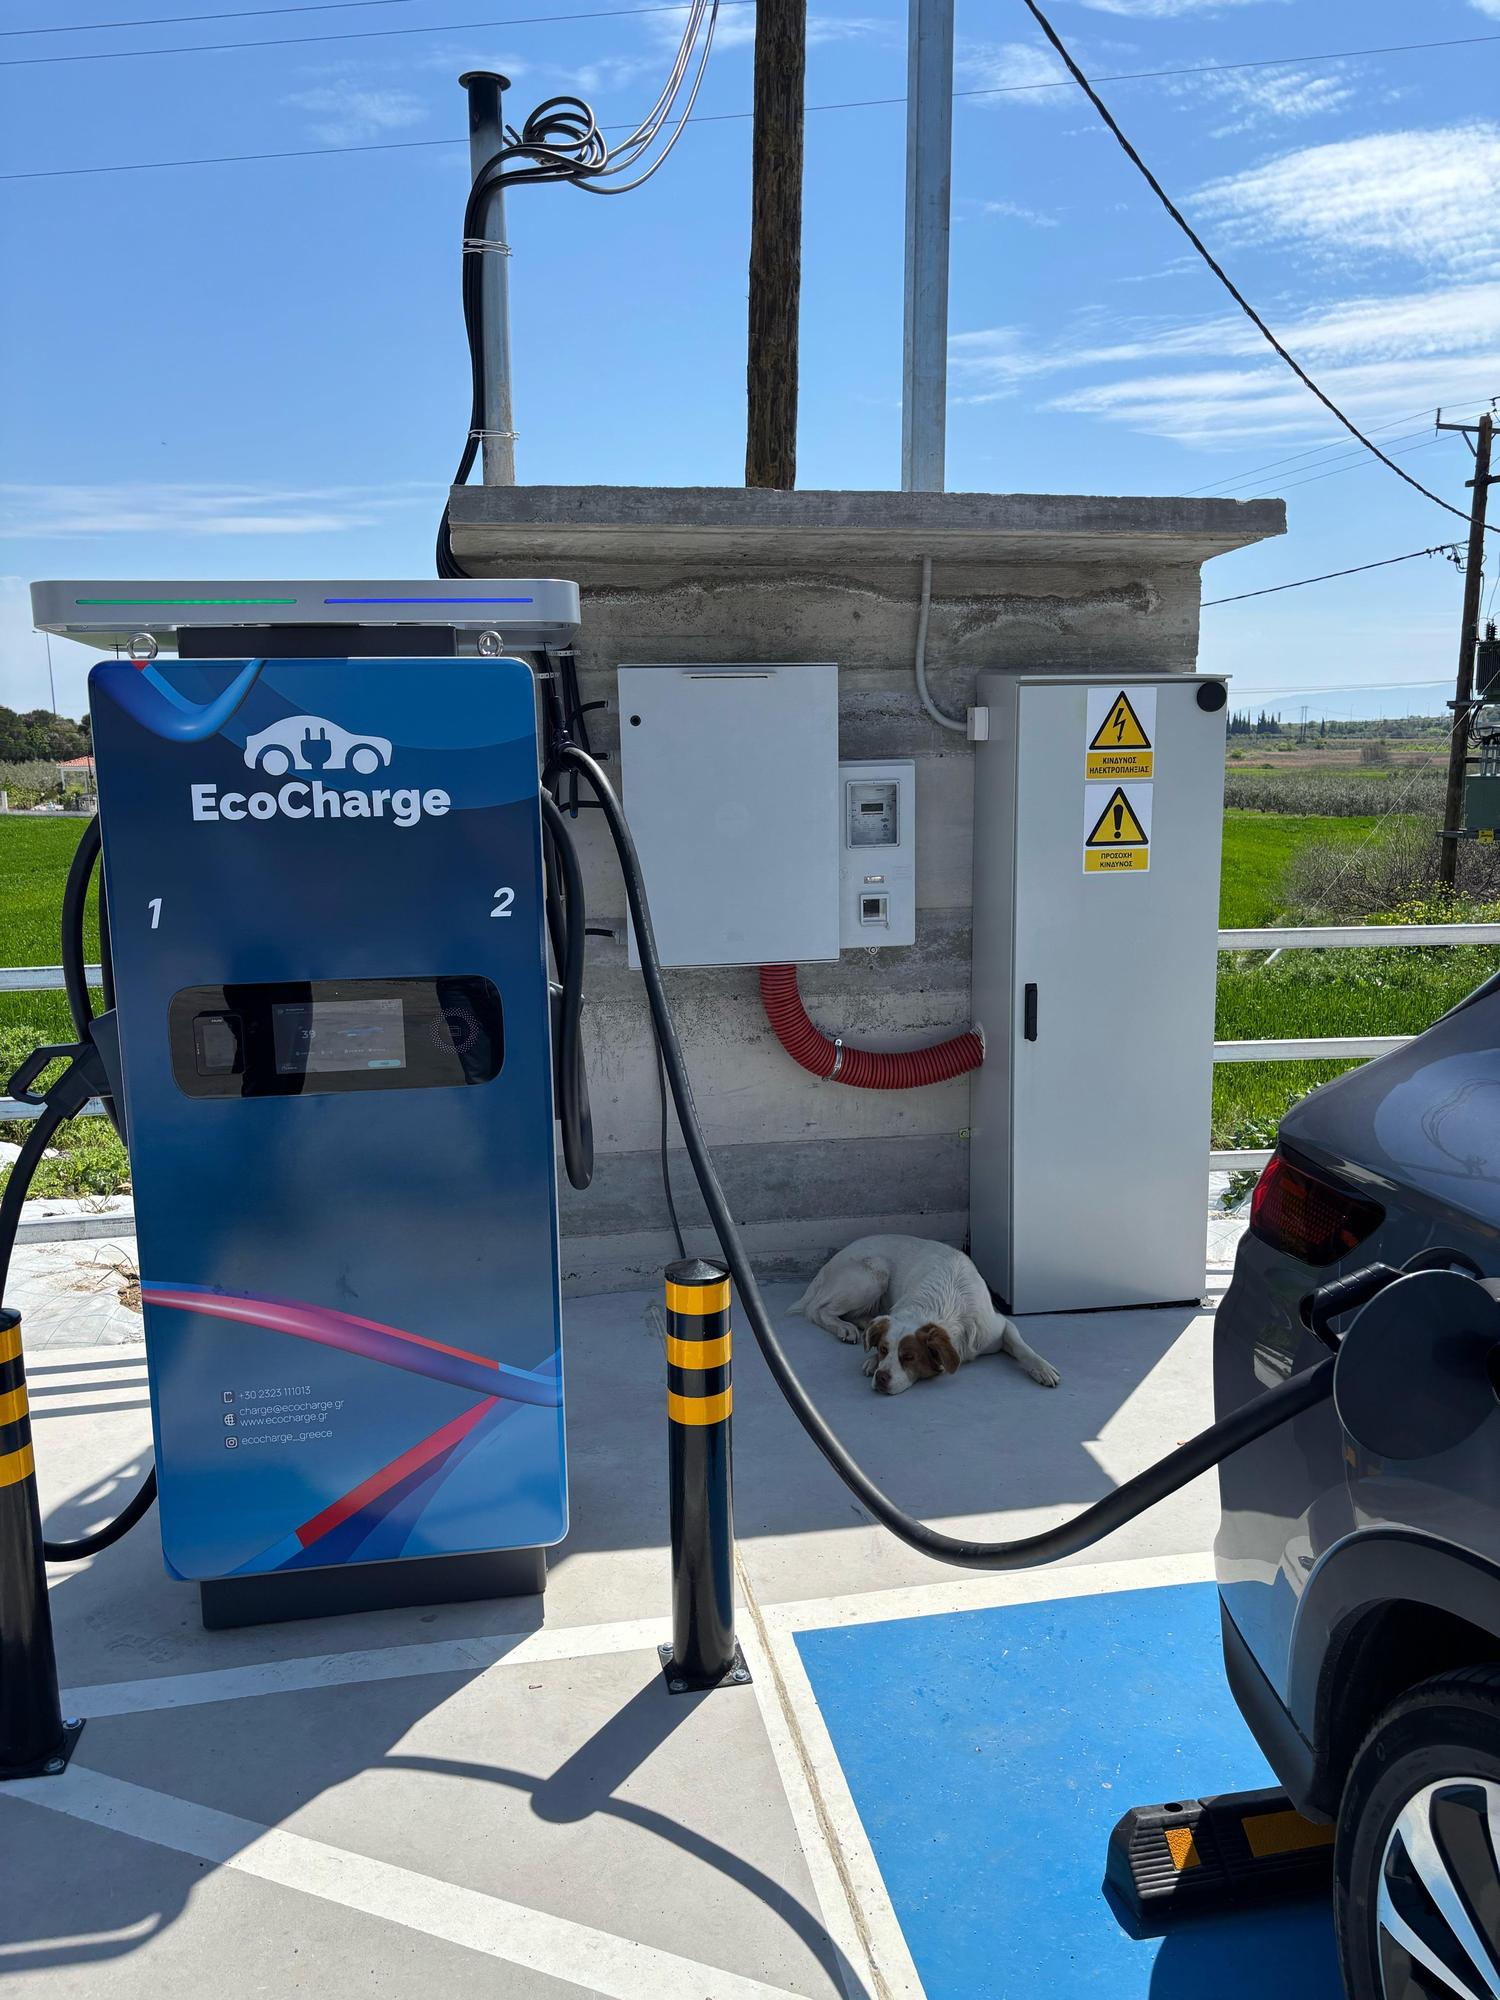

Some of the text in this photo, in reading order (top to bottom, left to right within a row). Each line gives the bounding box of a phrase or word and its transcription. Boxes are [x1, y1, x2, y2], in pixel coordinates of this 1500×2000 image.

[1102, 756, 1137, 764] ΚΙΝΔΥΝΟΣ
[1089, 766, 1150, 774] ΗΛΕΚΤΡΟΠΛΗΞΙΑΣ
[191, 781, 451, 827] EcoCharge
[1099, 860, 1133, 868] ΚΙΝΔΥΝΟΣ
[490, 887, 515, 917] 2
[148, 898, 162, 929] 1
[239, 1390, 256, 1400] +30
[258, 1388, 282, 1399] 2323
[239, 1412, 328, 1427] www.ecocharge.gr
